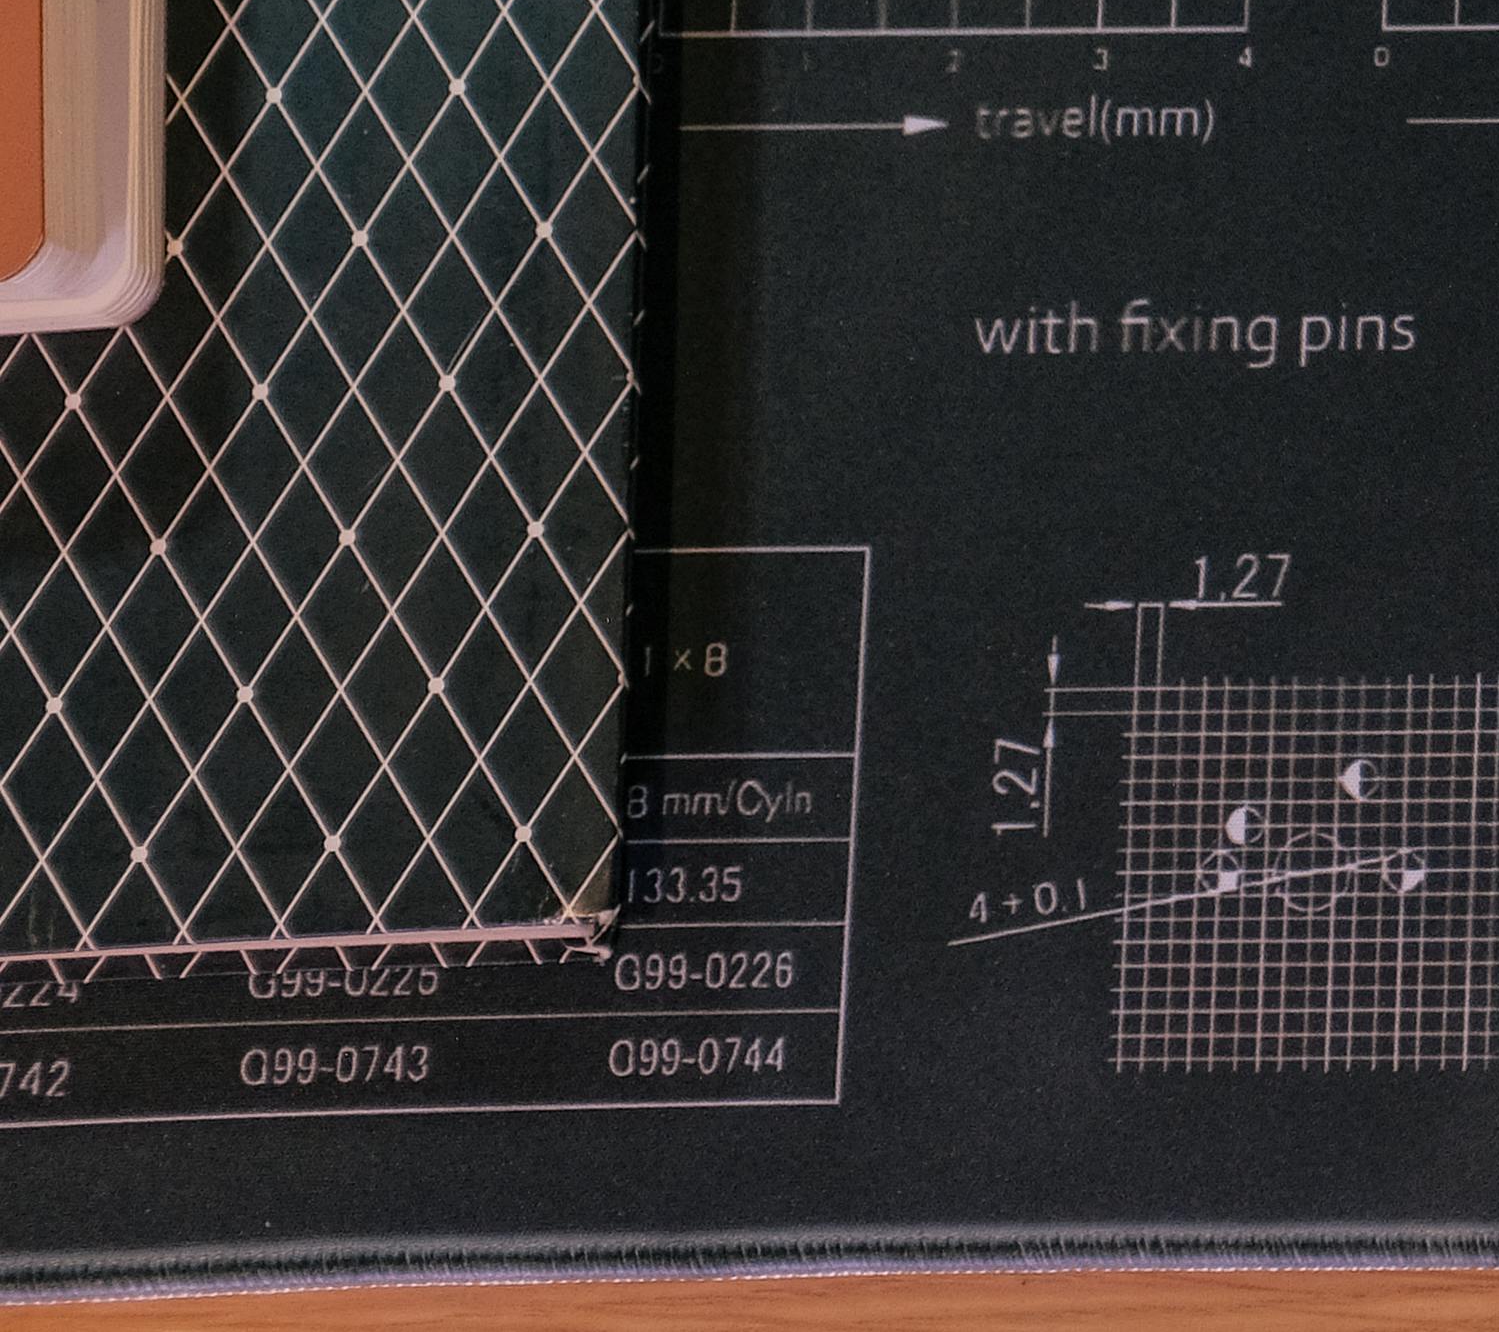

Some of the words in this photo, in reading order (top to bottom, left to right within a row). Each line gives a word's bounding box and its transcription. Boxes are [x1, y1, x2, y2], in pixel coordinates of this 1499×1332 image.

[976, 94, 1216, 147] travel(mm)
[974, 302, 1099, 356] with
[1118, 297, 1281, 371] fixing
[1300, 301, 1418, 370] pins
[614, 950, 795, 994] G99-0226
[239, 1045, 430, 1087] G99-0743
[608, 1036, 786, 1078] G99-0744
